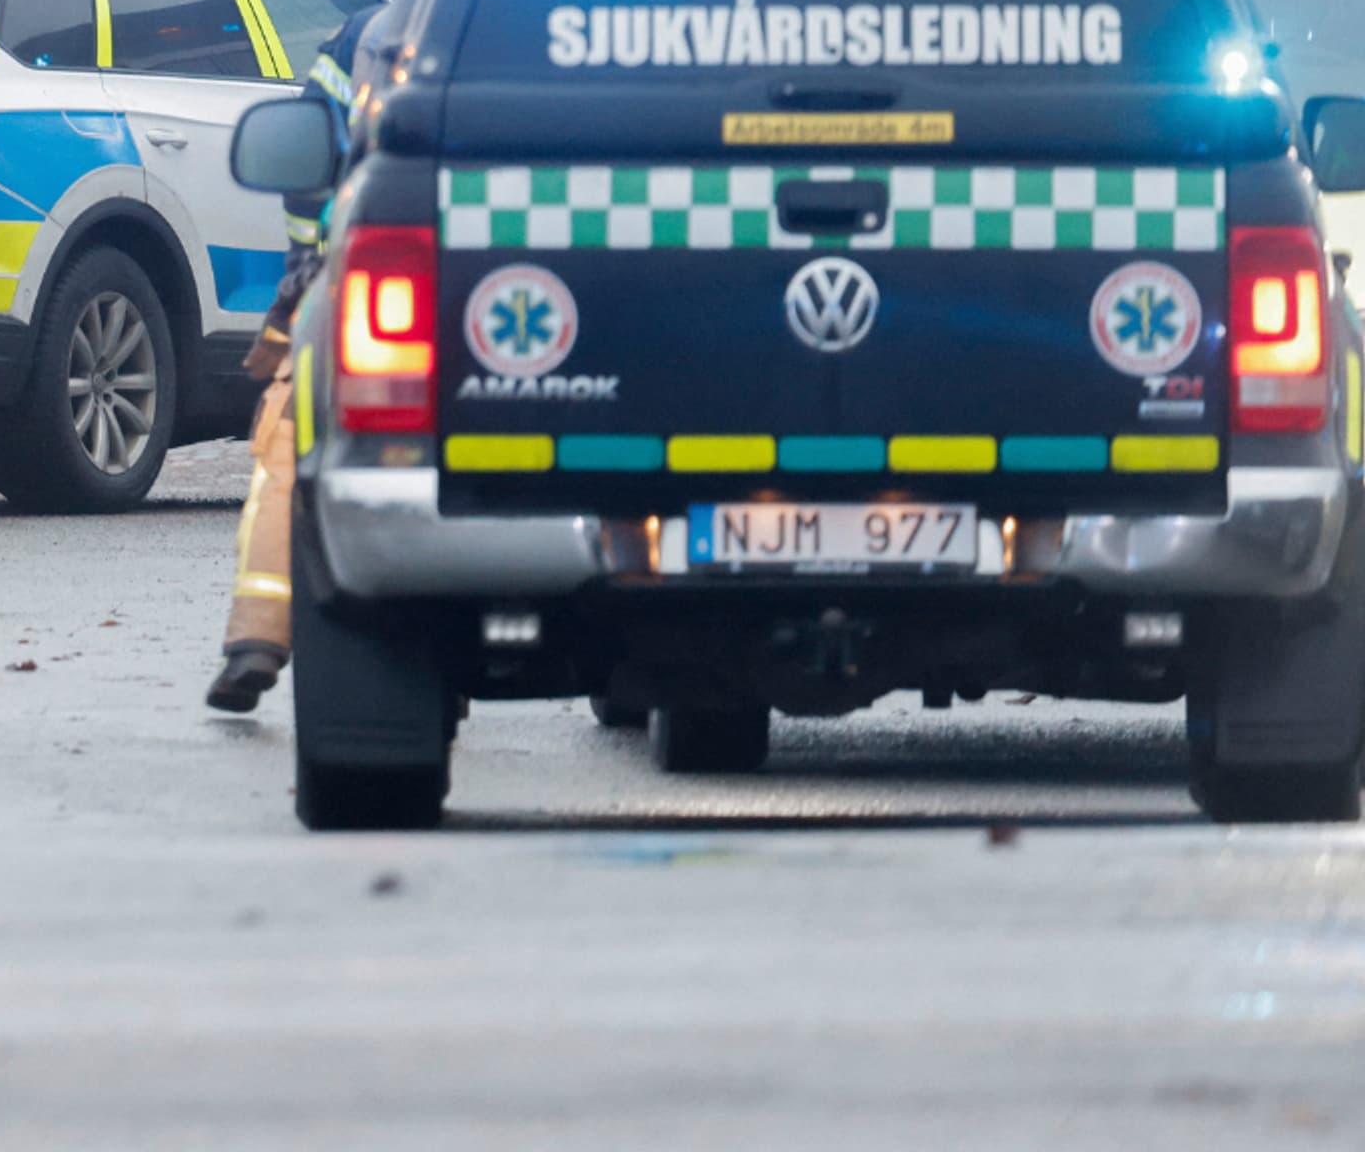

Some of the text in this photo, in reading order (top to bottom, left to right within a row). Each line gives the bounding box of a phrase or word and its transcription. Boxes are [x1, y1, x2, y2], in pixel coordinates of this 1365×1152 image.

[457, 374, 620, 400] AMAROK
[723, 511, 964, 554] NJM 977
